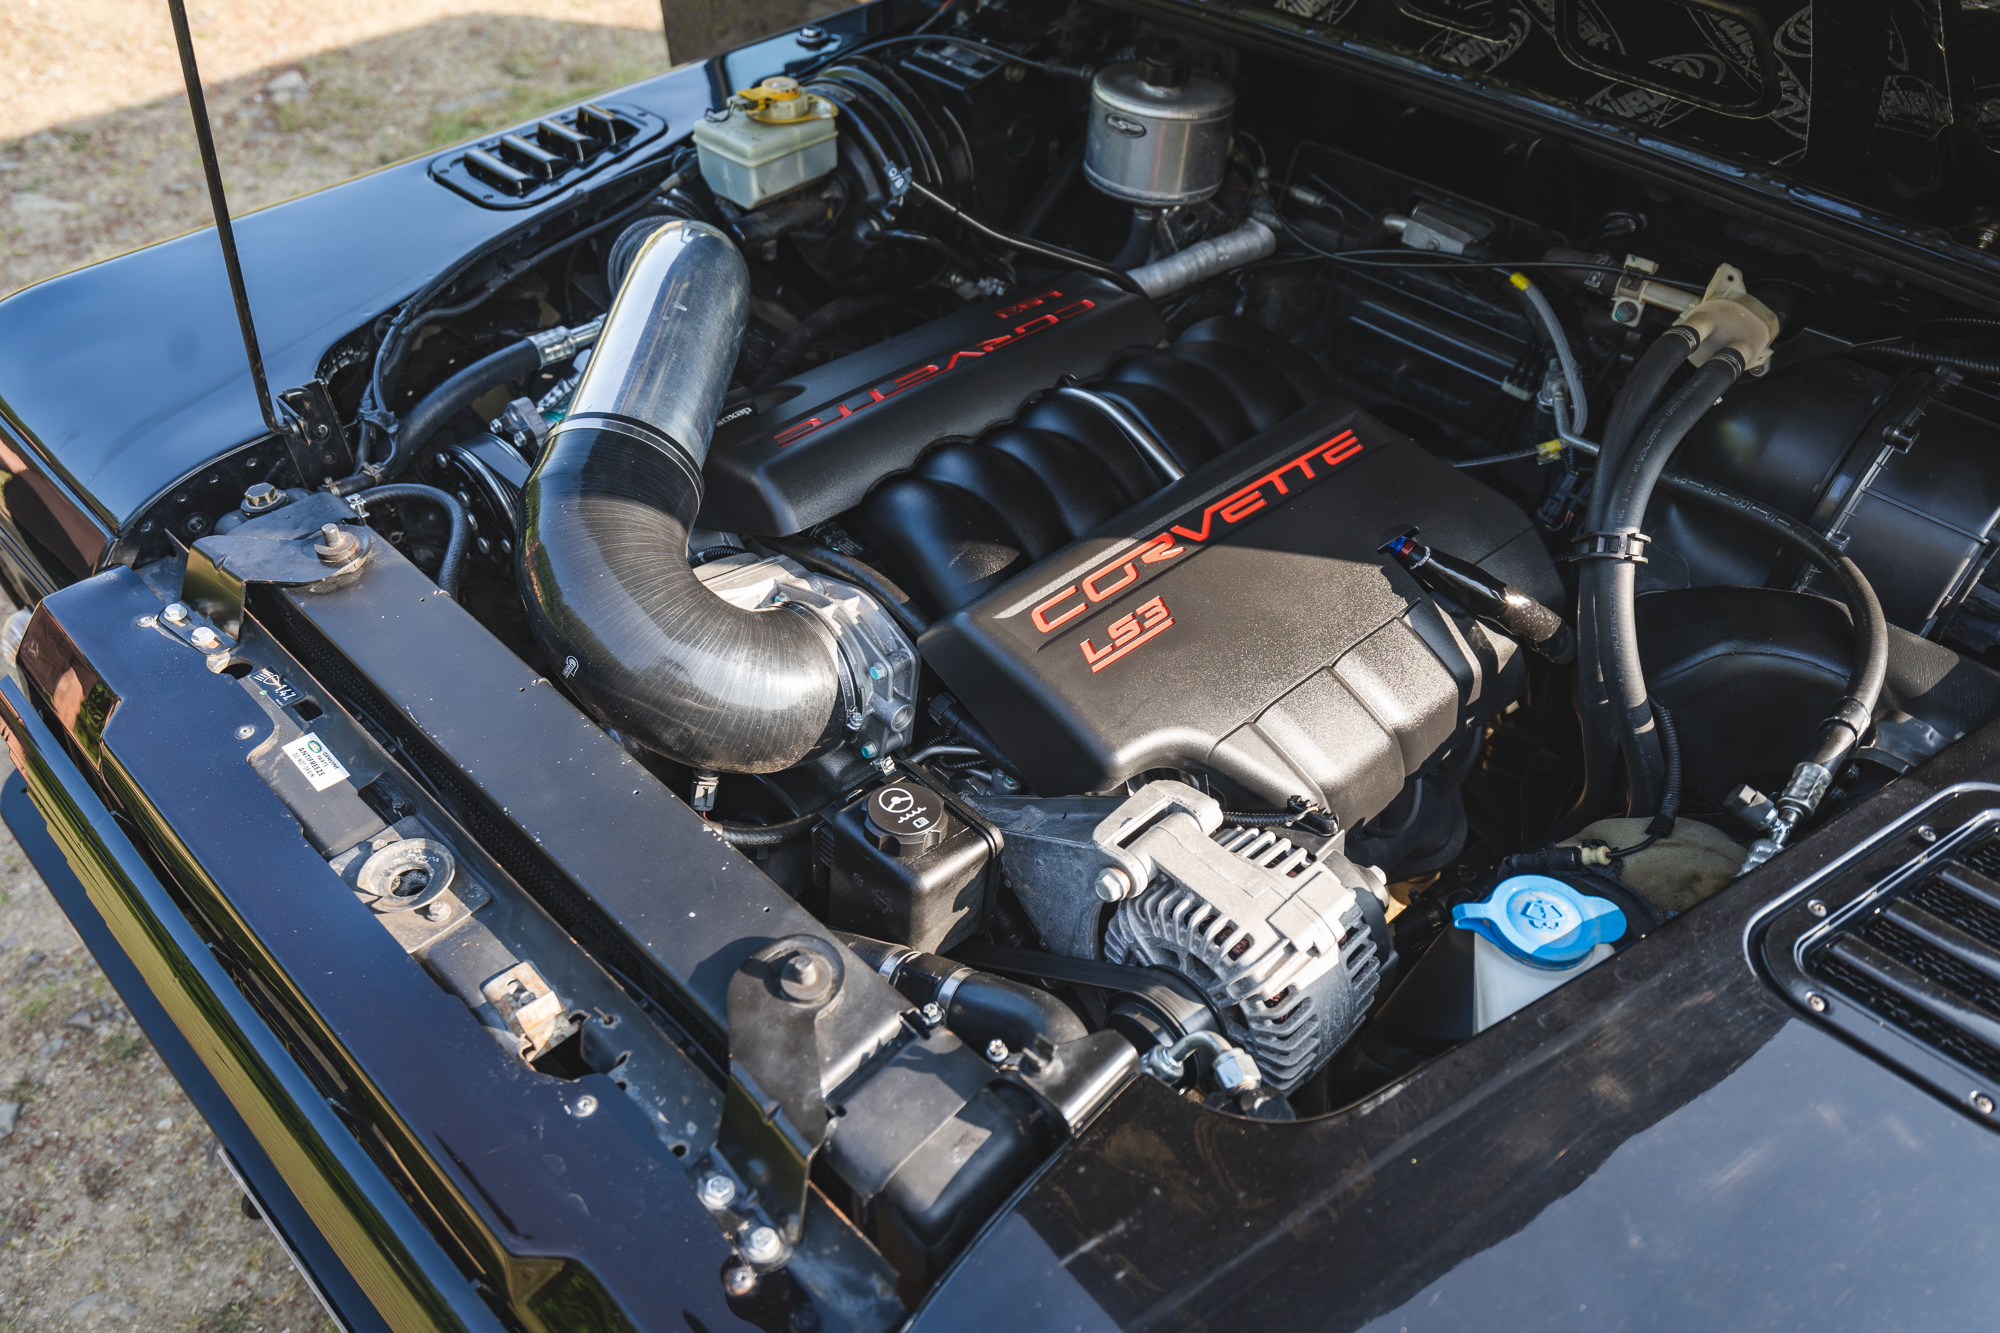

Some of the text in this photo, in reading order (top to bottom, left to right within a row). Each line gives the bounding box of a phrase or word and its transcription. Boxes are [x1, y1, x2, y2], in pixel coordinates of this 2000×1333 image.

[773, 298, 1096, 449] CORVETTE
[1031, 429, 1364, 634] CORVETTE
[1080, 595, 1173, 667] LS3
[298, 747, 326, 777] ANTIFREEZE
